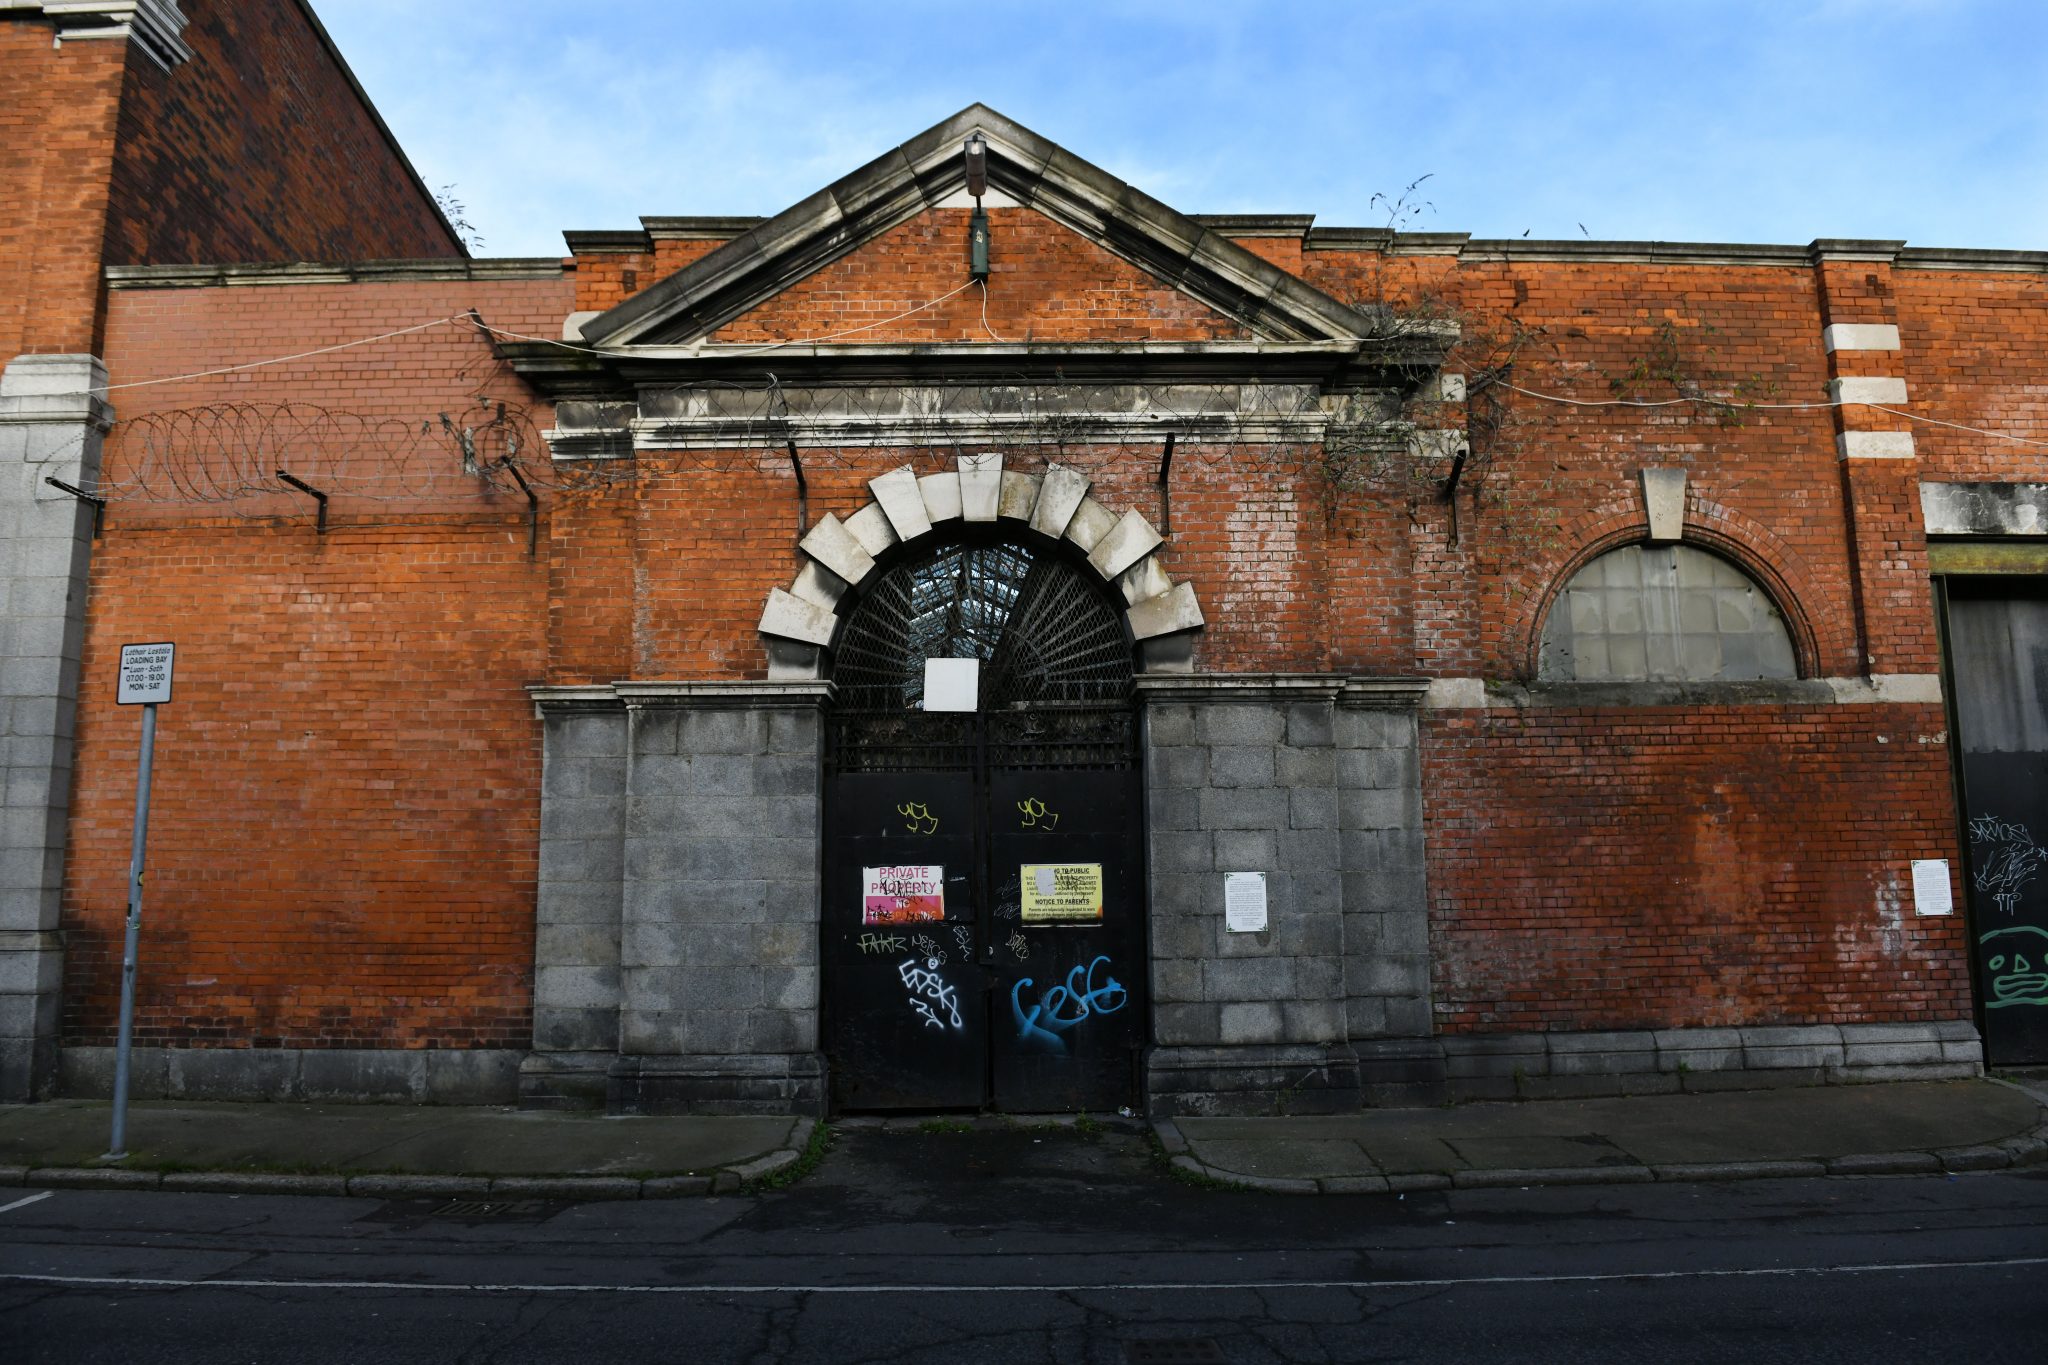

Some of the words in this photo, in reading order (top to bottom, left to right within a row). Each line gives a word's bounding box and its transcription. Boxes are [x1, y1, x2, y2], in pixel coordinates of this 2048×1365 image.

[148, 682, 160, 690] SAT
[880, 867, 929, 878] PRIVATE
[871, 882, 937, 894] PROPERTY
[869, 911, 937, 921] TSPAING
